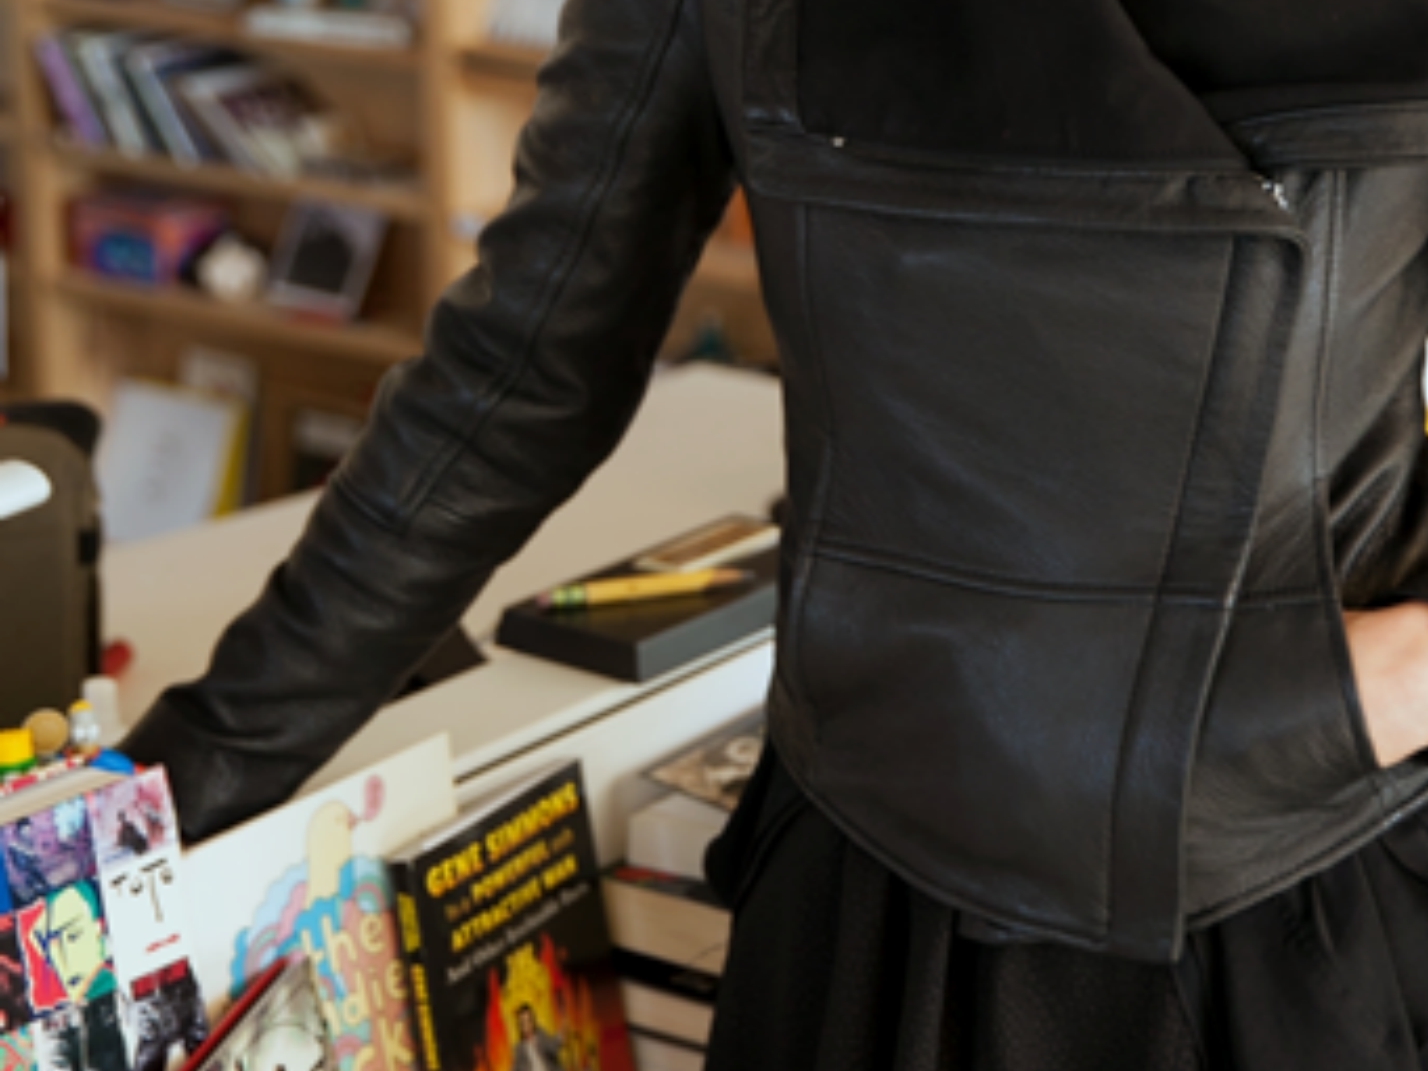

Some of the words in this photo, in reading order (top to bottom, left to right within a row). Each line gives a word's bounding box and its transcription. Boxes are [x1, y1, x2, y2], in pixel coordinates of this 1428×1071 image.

[426, 841, 484, 898] GENE
[485, 781, 580, 861] SIMMONS
[301, 913, 386, 976] the
